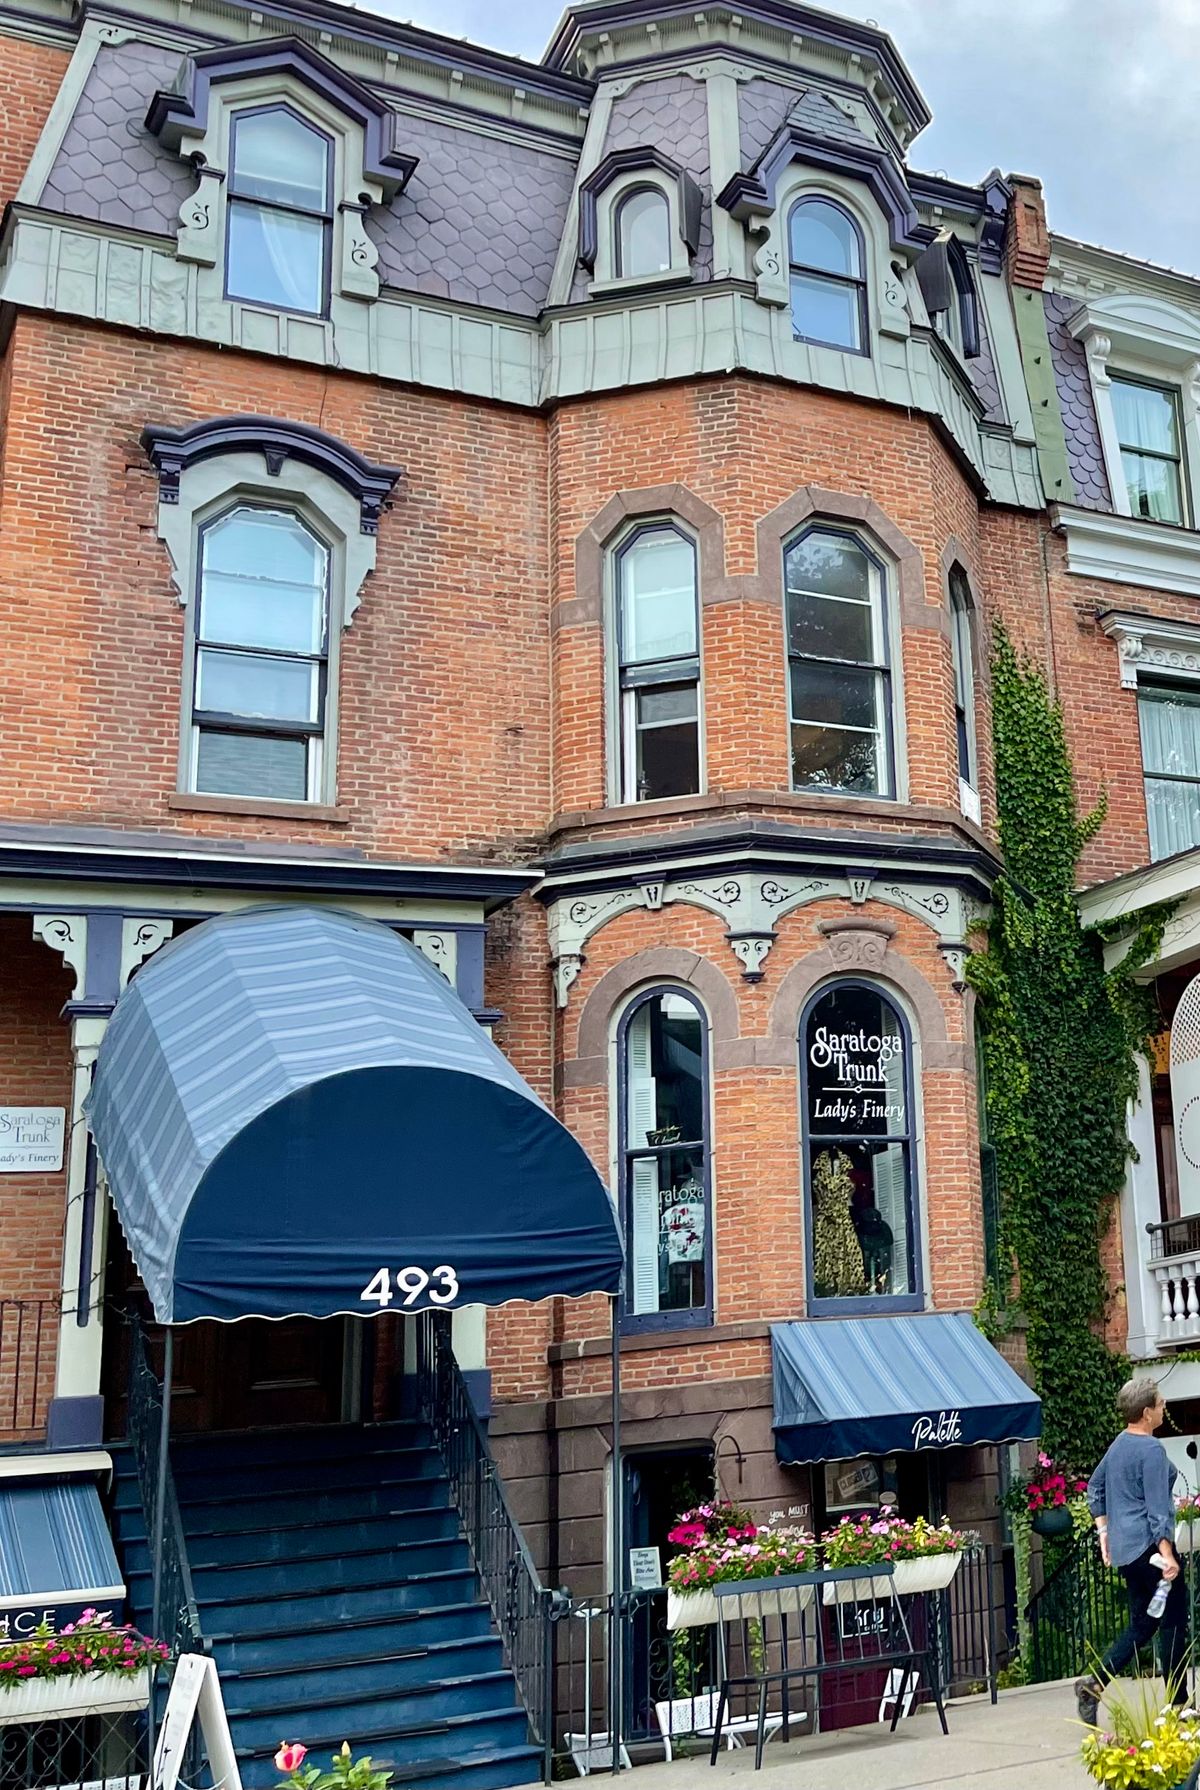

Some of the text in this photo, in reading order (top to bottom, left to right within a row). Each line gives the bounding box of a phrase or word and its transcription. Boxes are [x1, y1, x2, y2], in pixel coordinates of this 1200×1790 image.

[810, 1026, 903, 1068] Saratoga
[833, 1052, 889, 1082] Trunk
[814, 1098, 905, 1122] Lady's Finery
[0, 1113, 61, 1133] Saratoga
[13, 1126, 50, 1143] Trunk
[0, 1152, 59, 1165] ady's Finery
[360, 1265, 459, 1306] 493
[911, 1411, 962, 1450] Palette
[788, 1503, 809, 1517] MUST
